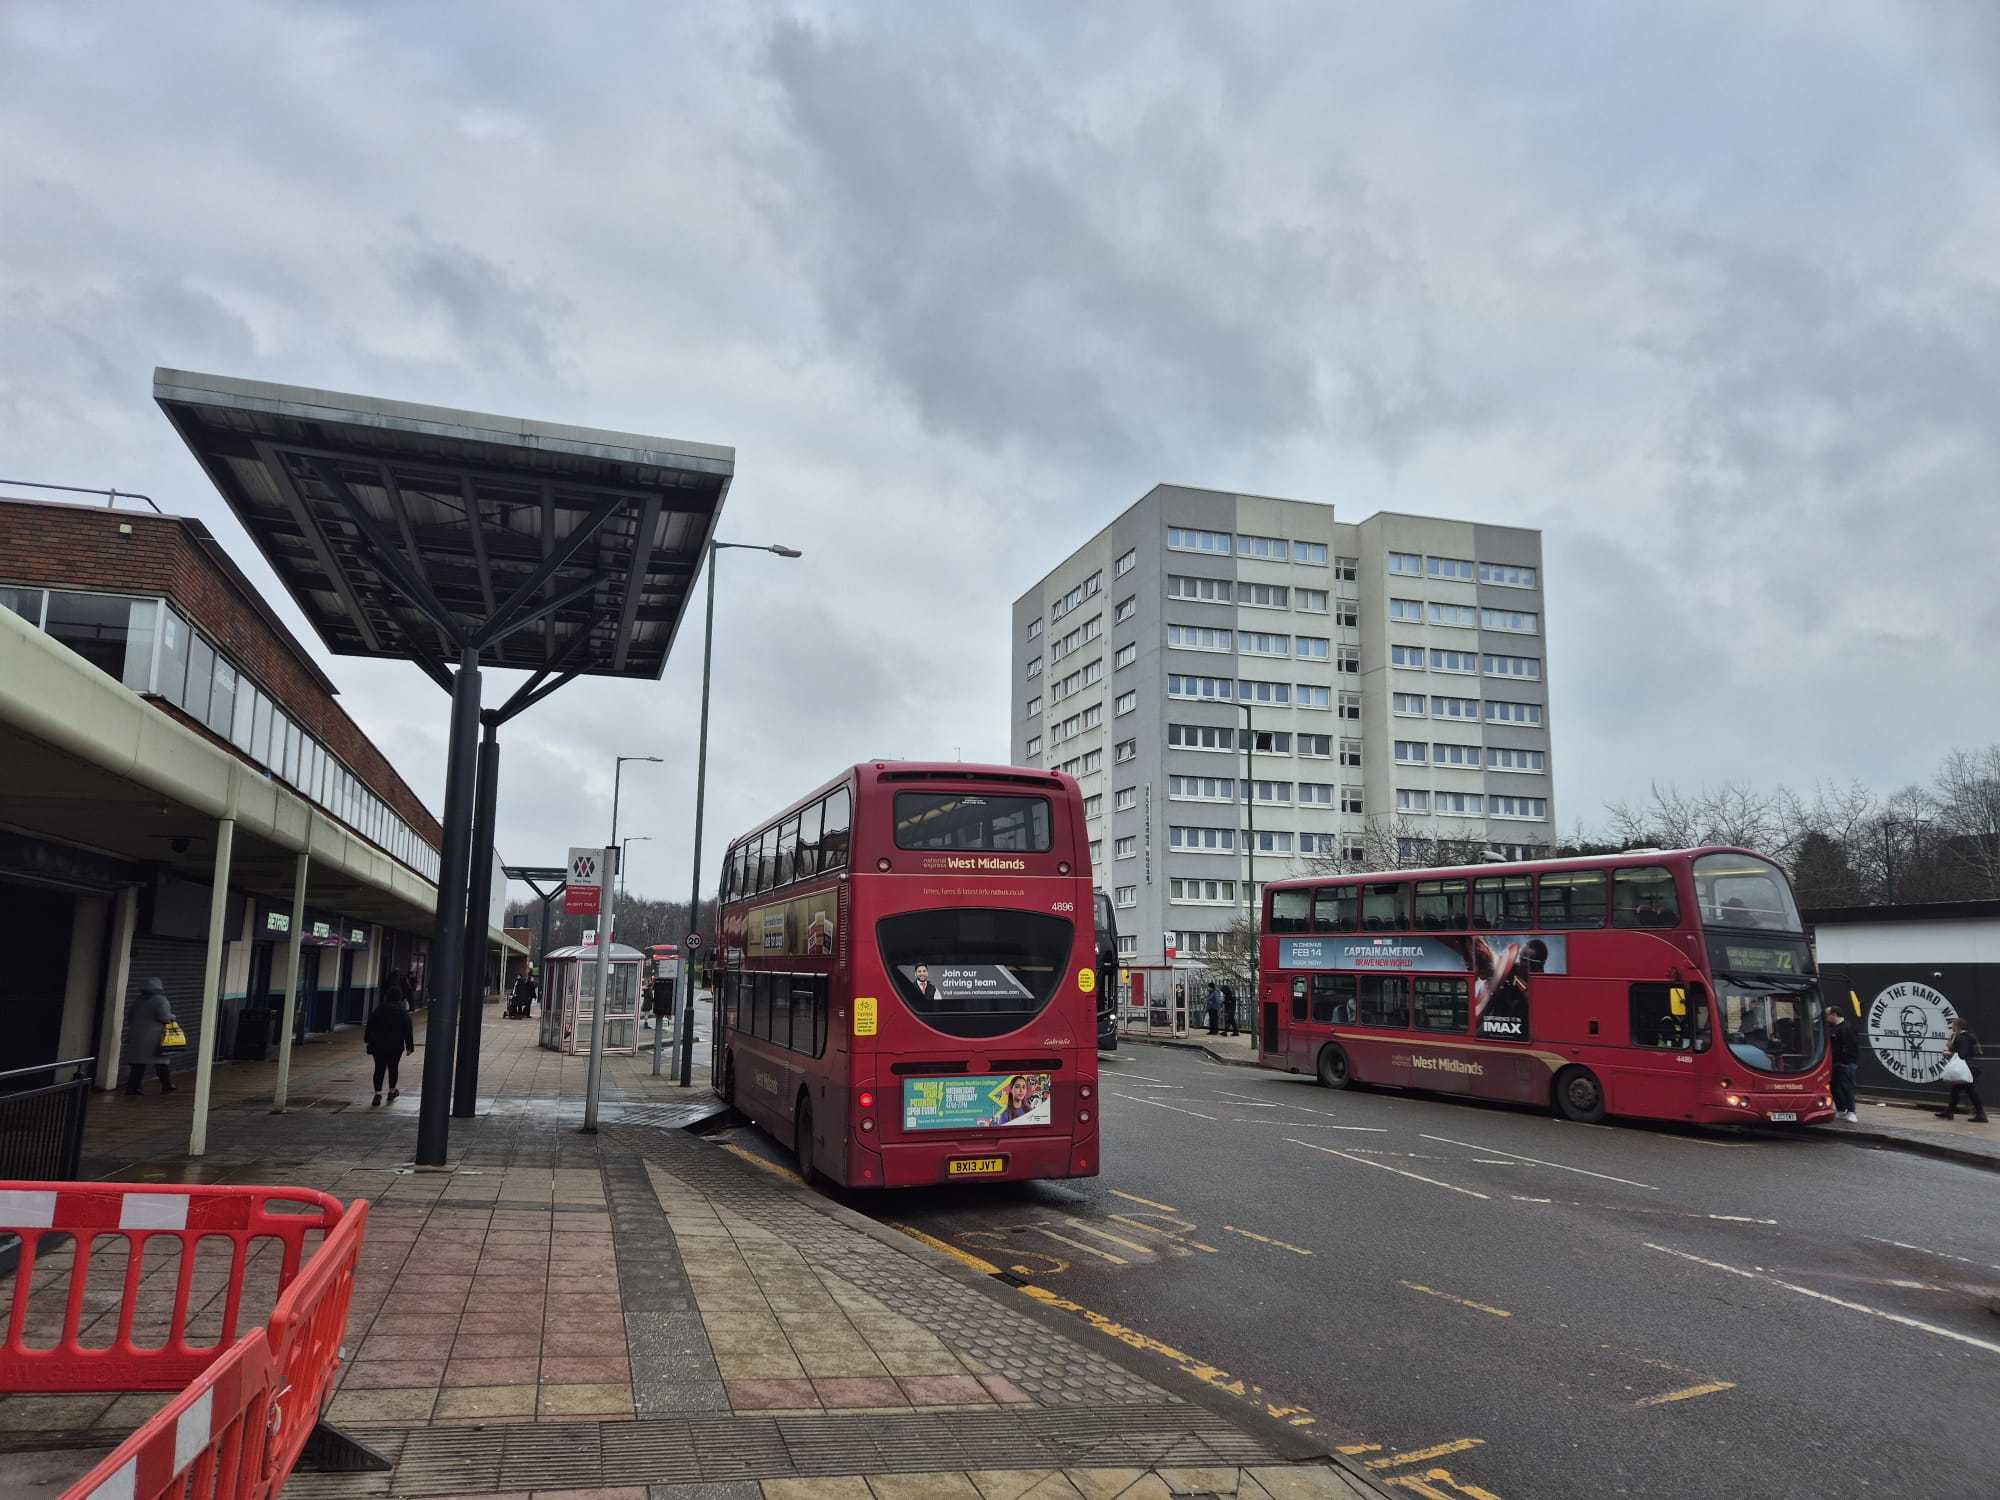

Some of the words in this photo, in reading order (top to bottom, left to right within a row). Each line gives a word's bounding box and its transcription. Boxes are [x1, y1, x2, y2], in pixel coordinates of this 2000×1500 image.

[947, 857, 976, 869] West
[978, 858, 1025, 870] Midlands
[1052, 902, 1074, 912] 4896
[688, 937, 700, 946] 20
[1292, 948, 1310, 957] FEB
[1311, 948, 1322, 957] 14
[1344, 946, 1382, 957] CAPTAIN
[1383, 946, 1425, 957] AMERICA
[1775, 951, 1792, 969] 72
[942, 969, 961, 978] Join
[962, 970, 977, 978] our
[942, 979, 973, 988] driving
[974, 979, 997, 987] team
[1870, 999, 1888, 1029] MADE
[1887, 986, 1907, 1001] THE
[1912, 985, 1941, 1006] HARD
[1483, 1021, 1522, 1034] IMAX
[1412, 1055, 1438, 1070] West
[1438, 1058, 1484, 1075] Midlands
[1880, 1050, 1906, 1075] MADE
[1911, 1069, 1924, 1079] BY
[956, 1161, 977, 1172] BX13
[979, 1161, 996, 1171] JVT
